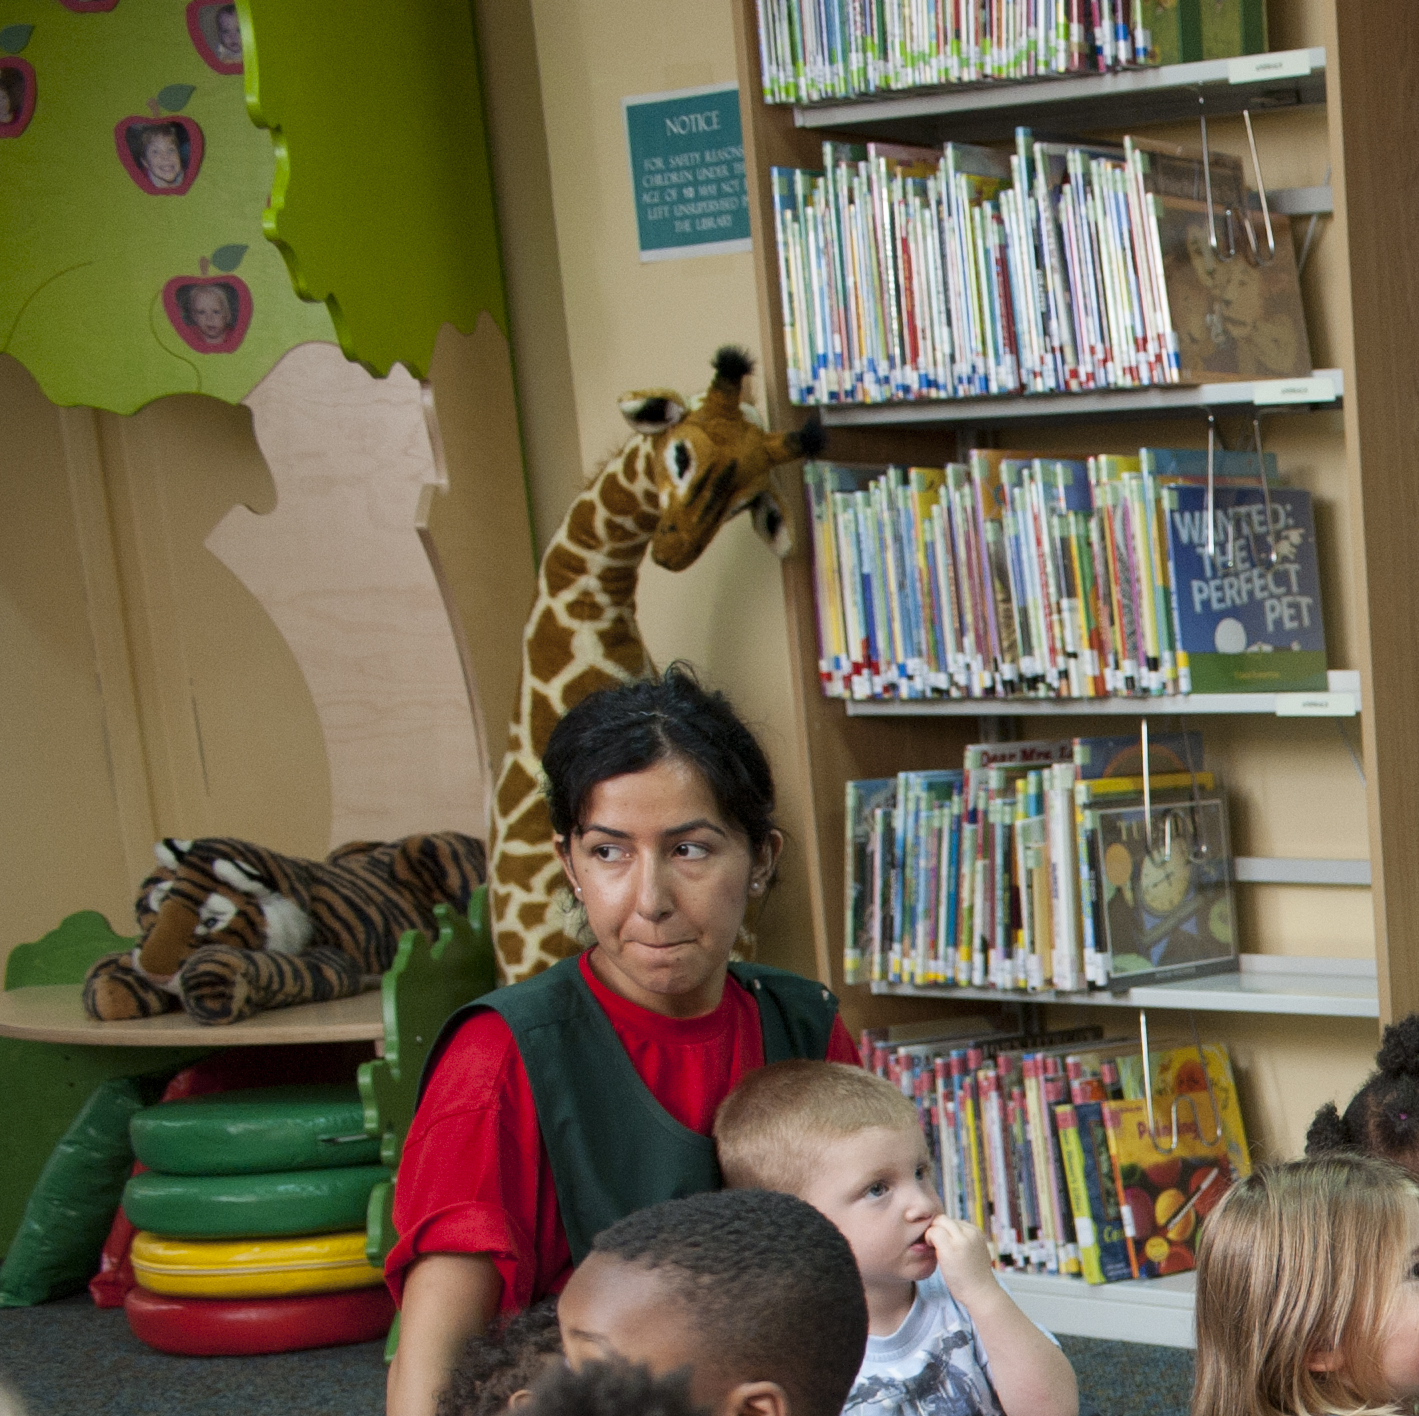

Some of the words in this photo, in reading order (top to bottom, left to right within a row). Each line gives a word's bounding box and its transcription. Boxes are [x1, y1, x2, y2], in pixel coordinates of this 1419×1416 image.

[664, 110, 721, 136] NOTICE
[1195, 538, 1250, 578] THE
[1191, 563, 1300, 614] PERFECT
[1264, 595, 1313, 633] PET
